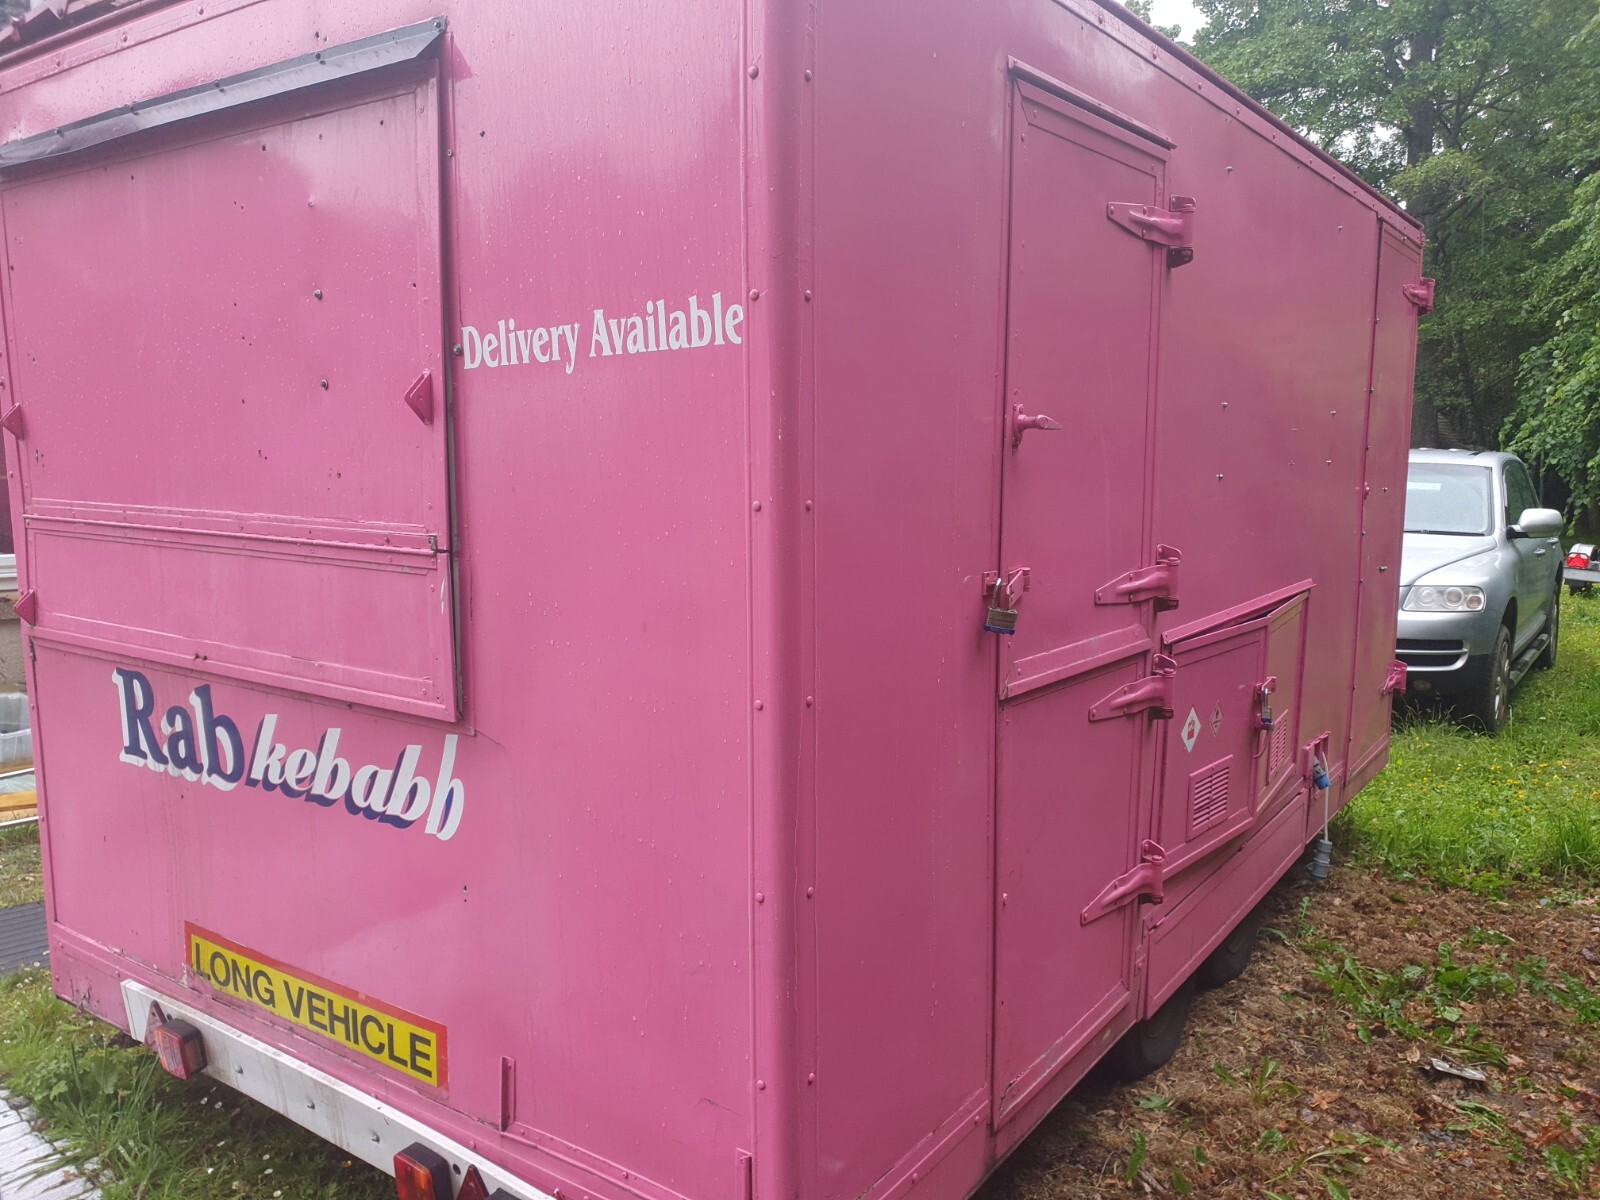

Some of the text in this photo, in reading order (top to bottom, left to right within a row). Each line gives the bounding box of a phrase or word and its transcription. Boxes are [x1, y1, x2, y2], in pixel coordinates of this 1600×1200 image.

[461, 292, 744, 375] Delivery Available
[195, 942, 433, 1079] LONG VEHICLE
